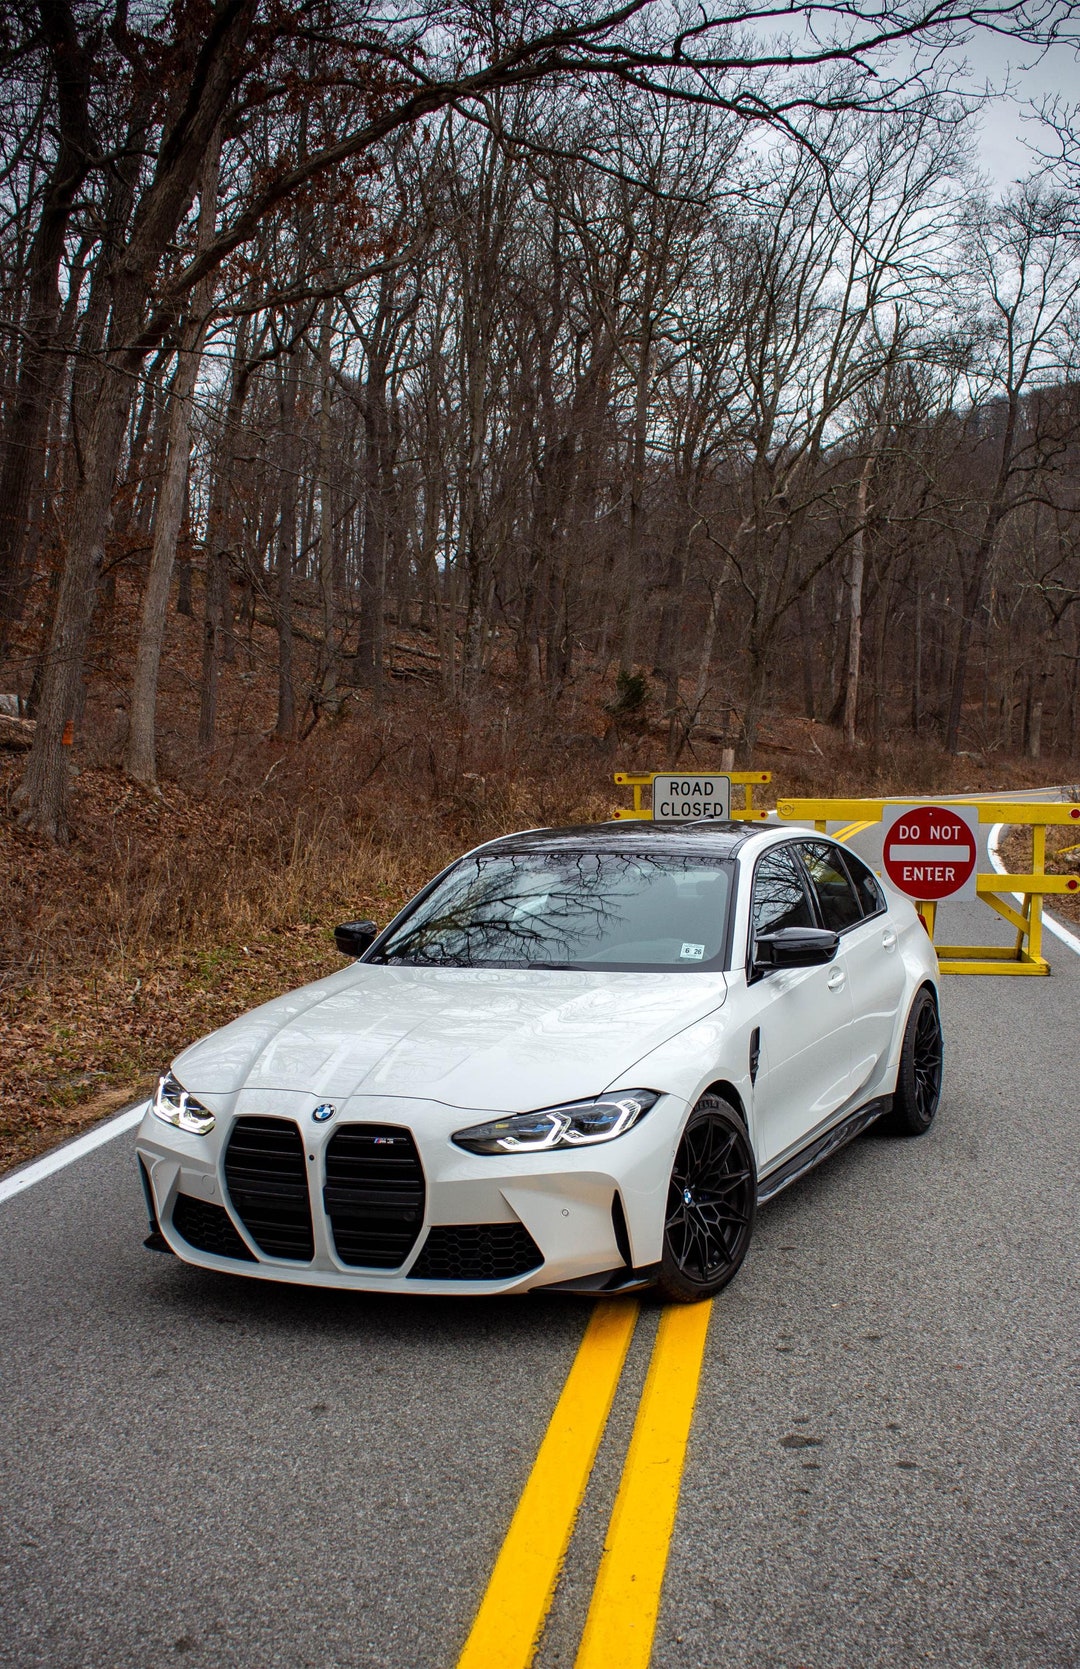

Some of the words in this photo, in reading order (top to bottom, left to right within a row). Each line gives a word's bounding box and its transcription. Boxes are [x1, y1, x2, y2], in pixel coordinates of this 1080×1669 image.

[670, 781, 714, 796] ROAD
[660, 801, 723, 817] CLOSED
[899, 825, 921, 840] DO
[930, 825, 961, 840] NOT
[903, 866, 955, 881] ENTER
